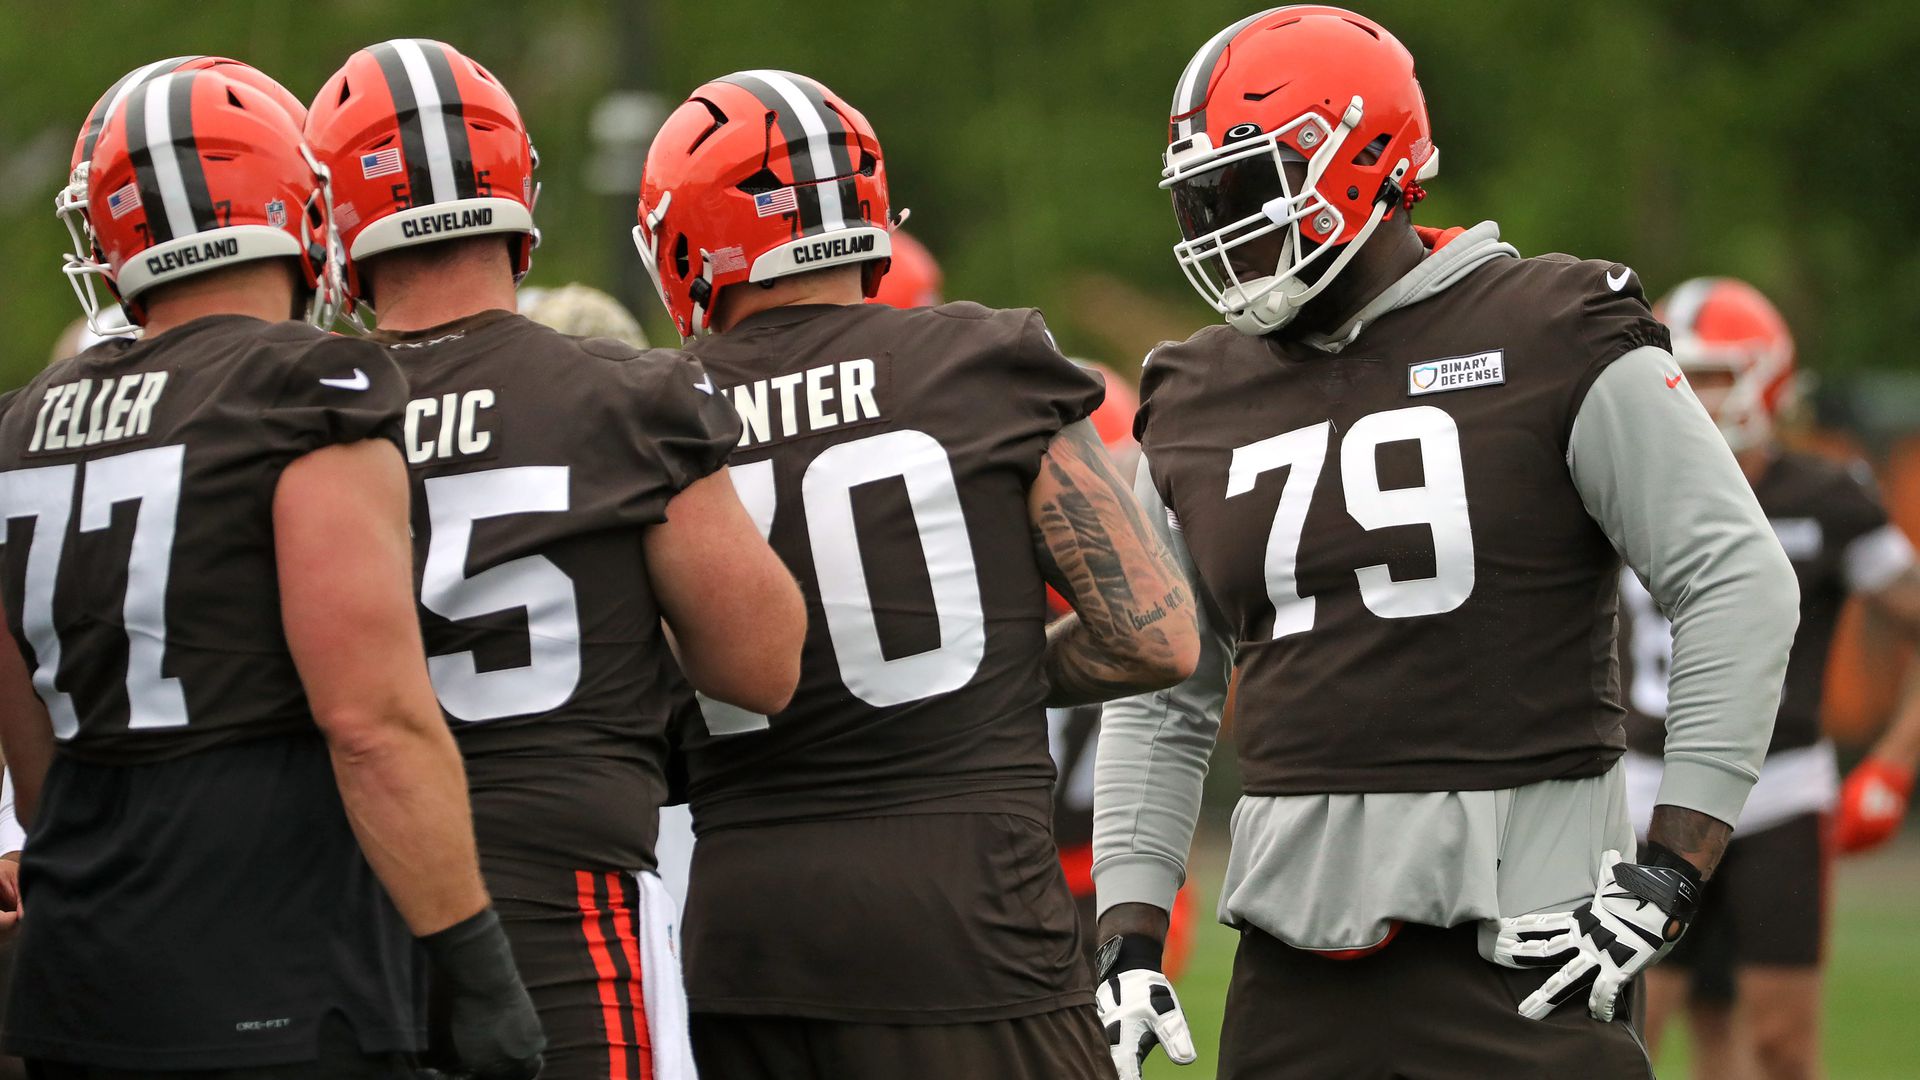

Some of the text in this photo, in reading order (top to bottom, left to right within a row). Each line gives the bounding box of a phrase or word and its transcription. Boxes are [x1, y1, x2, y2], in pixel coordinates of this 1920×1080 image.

[401, 207, 493, 238] CLEVELAND
[147, 237, 239, 276] CLEVELAND
[793, 234, 875, 265] CLEVELAND
[1441, 357, 1488, 374] BINARY
[1441, 367, 1500, 387] DEFENSE
[28, 371, 168, 453] TELLER
[720, 358, 881, 447] NTER
[1225, 405, 1475, 640] 79
[0, 444, 189, 740] 77
[1126, 601, 1167, 632] Isaiah
